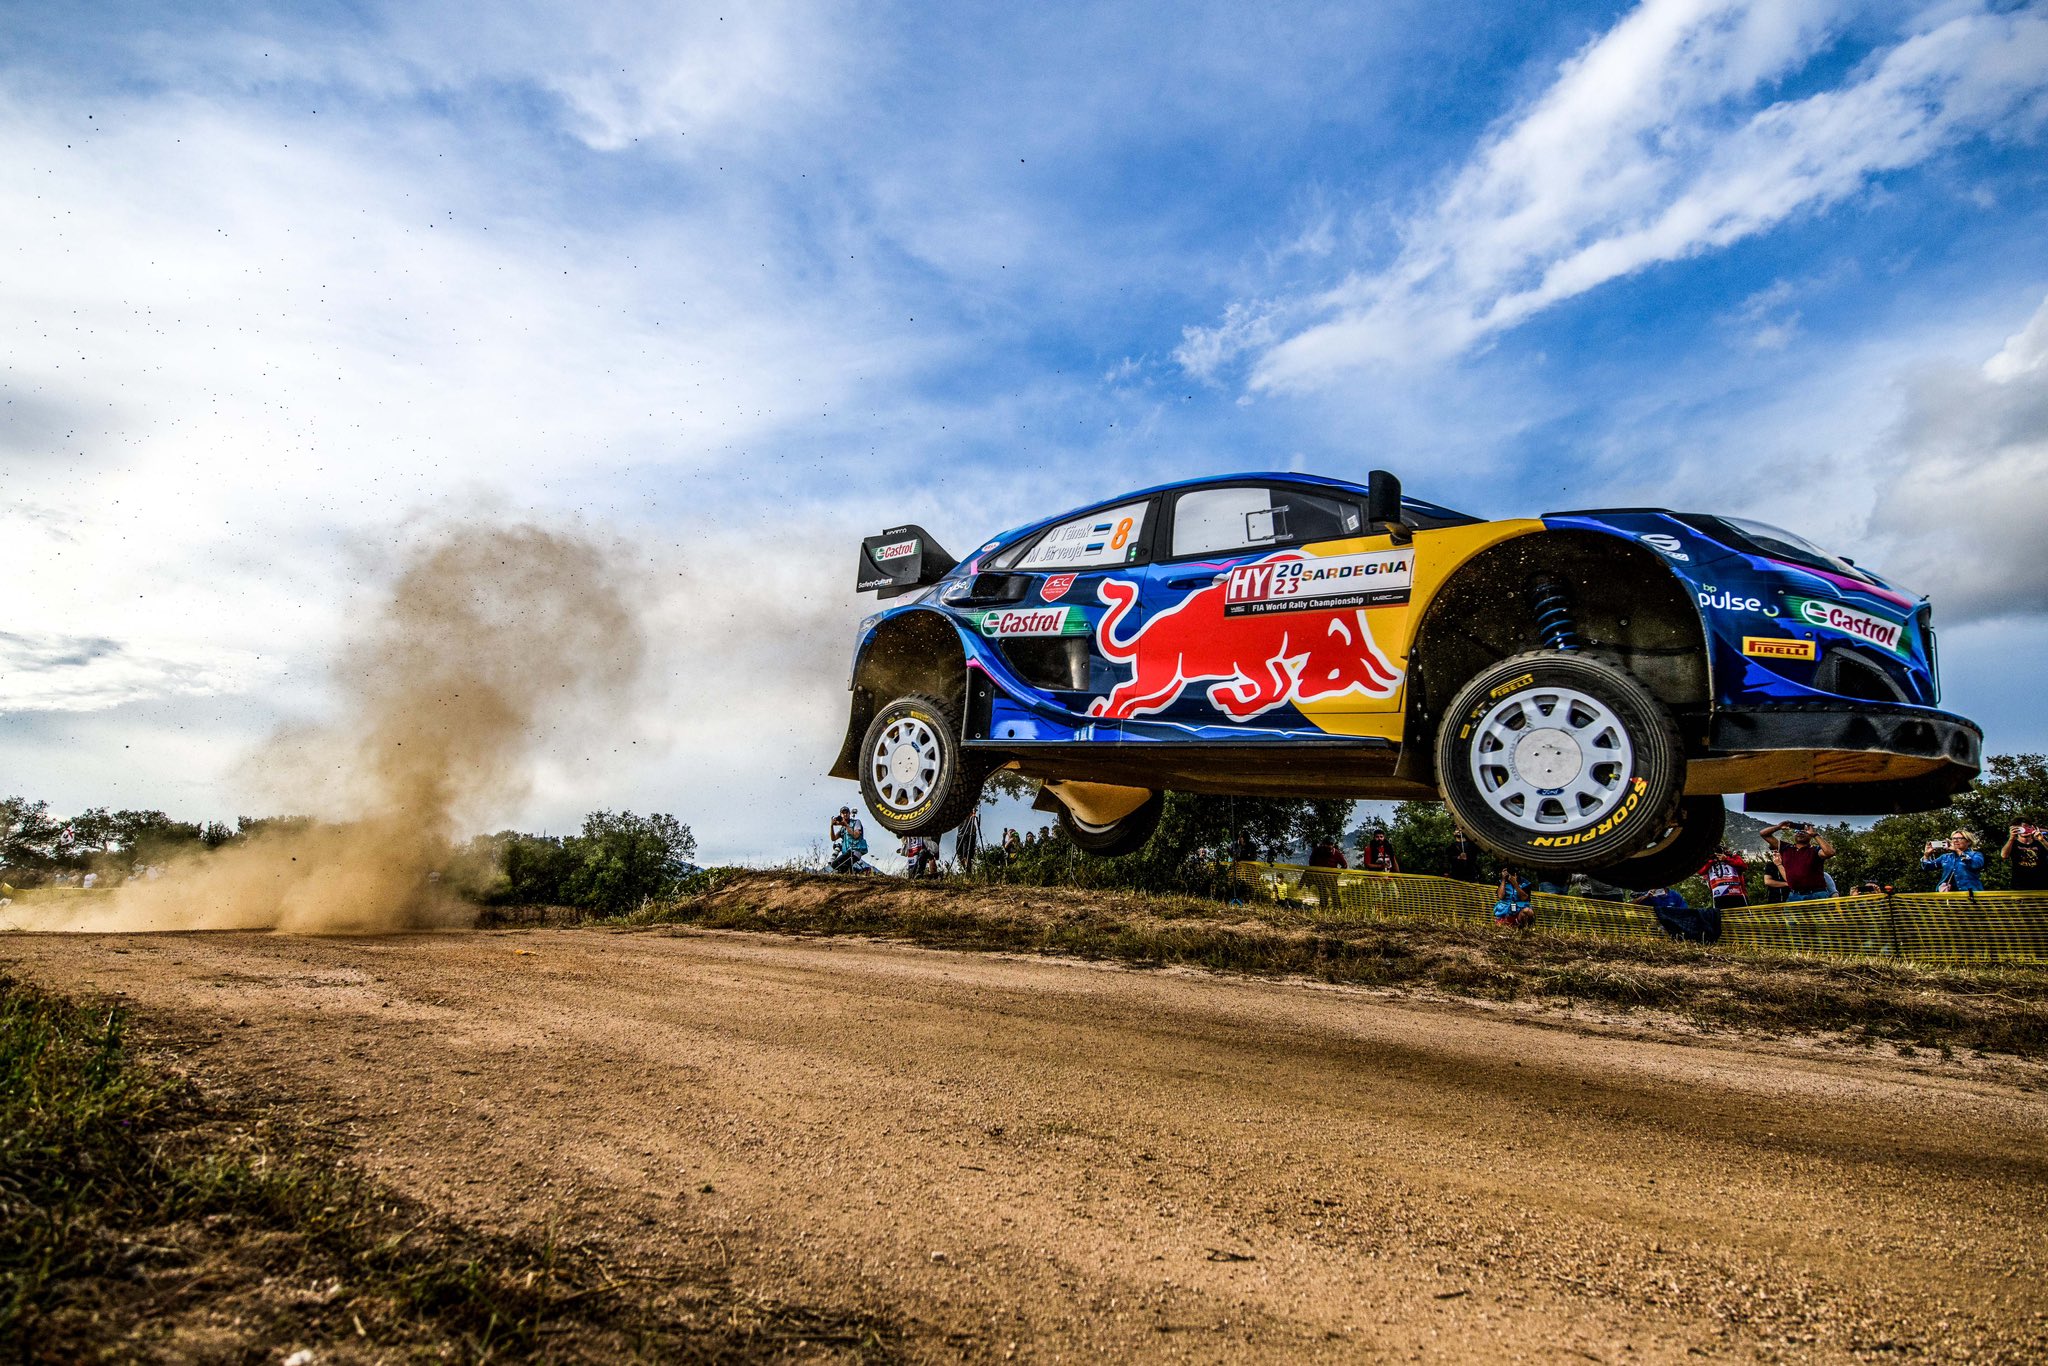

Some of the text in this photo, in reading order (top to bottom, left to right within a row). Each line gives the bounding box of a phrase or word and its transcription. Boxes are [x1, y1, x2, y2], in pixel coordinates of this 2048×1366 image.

[1110, 517, 1134, 550] 8
[884, 542, 914, 558] Castrol
[1276, 562, 1303, 578] 20
[1302, 560, 1408, 581] SARDEGNA
[858, 578, 893, 588] SafetyCulture
[1229, 567, 1273, 599] HY
[1274, 577, 1300, 595] 23
[1702, 583, 1717, 593] bp
[1252, 596, 1364, 612] FIA World Rally Championship
[1698, 591, 1761, 612] pulse
[1000, 610, 1062, 633] Castrol
[1829, 608, 1896, 646] Castrol
[1749, 641, 1809, 656] PIRELLI
[1490, 673, 1534, 699] PIRELLI
[876, 800, 932, 821] SCORPION
[1533, 777, 1648, 847] SCORPION
